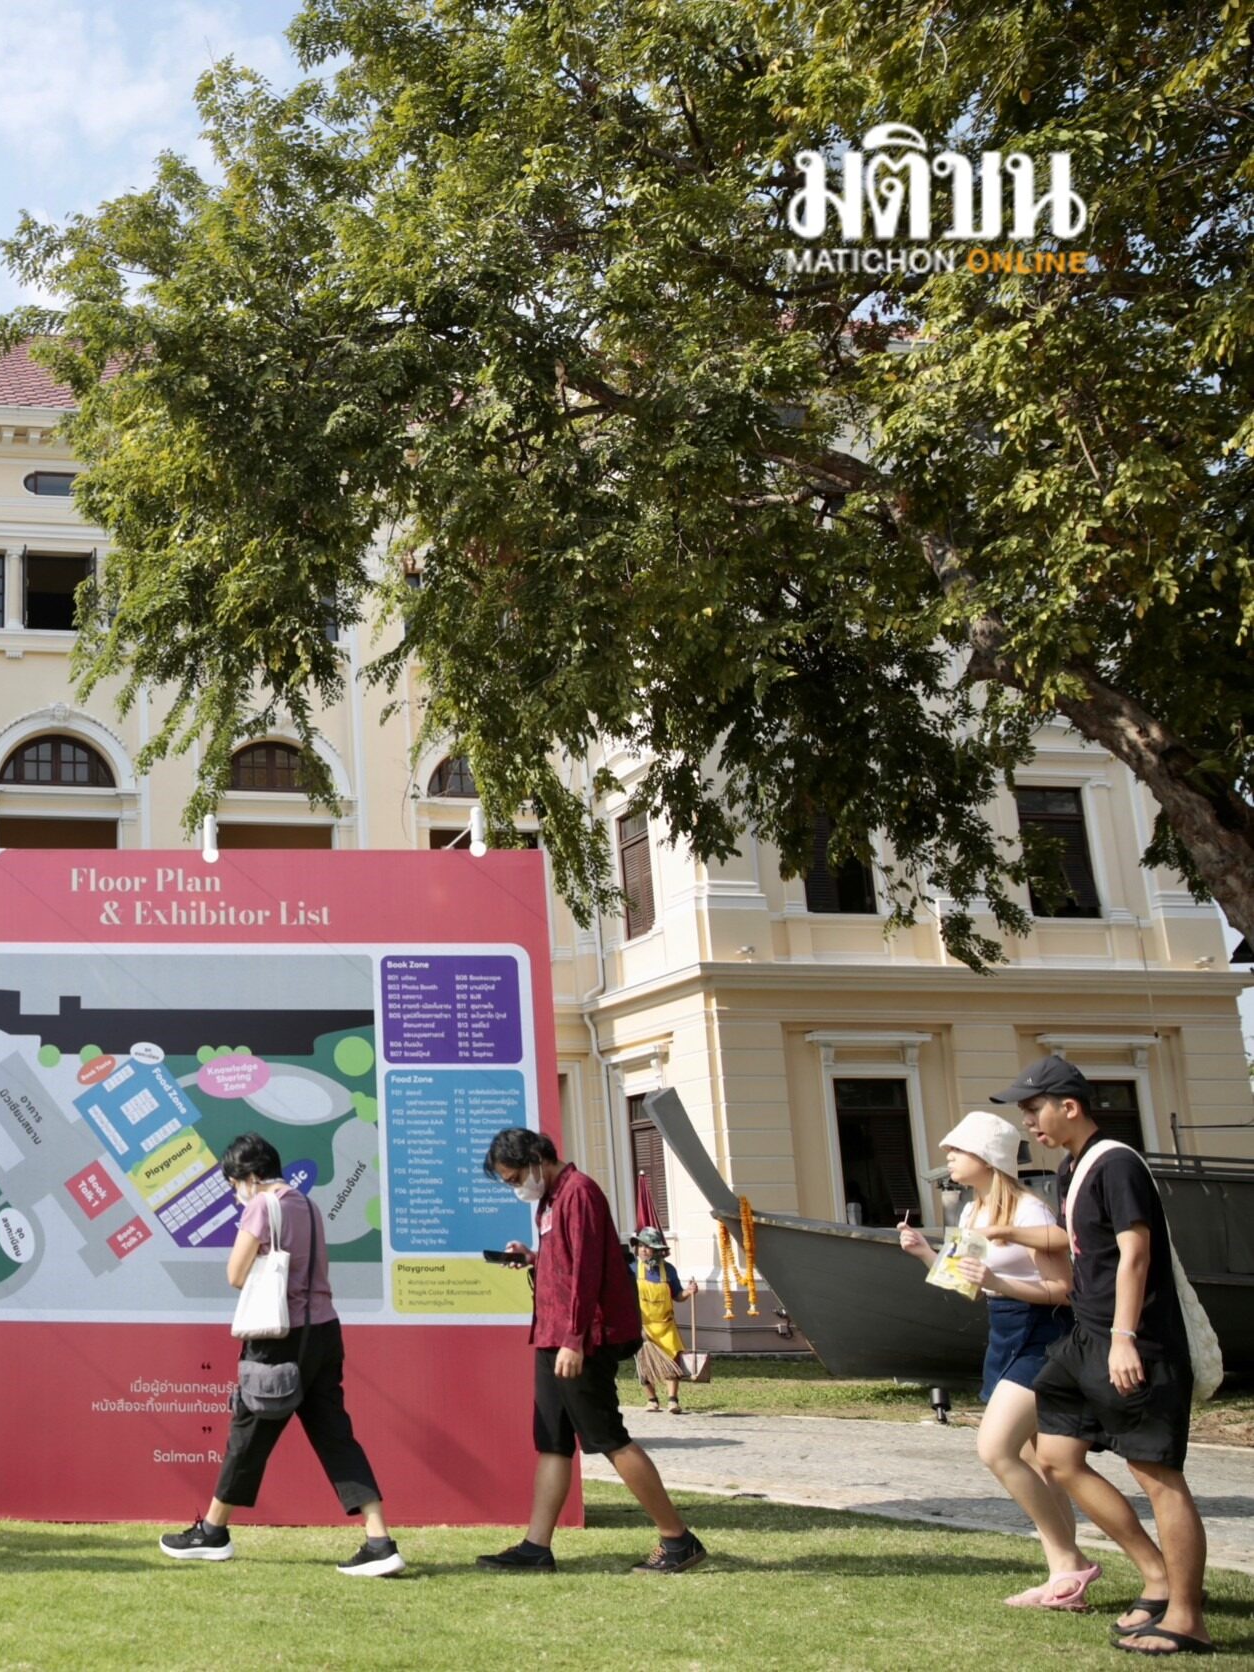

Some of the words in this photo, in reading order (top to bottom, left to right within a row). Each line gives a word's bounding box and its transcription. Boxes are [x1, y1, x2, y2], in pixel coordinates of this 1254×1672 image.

[70, 868, 147, 892] Floor
[155, 868, 221, 892] Plan
[99, 901, 122, 926] &
[134, 900, 270, 926] Exhibitor
[280, 901, 332, 926] List
[387, 960, 407, 968] Book
[206, 1063, 258, 1076] Knowledge
[216, 1073, 251, 1083] Sharing
[391, 1076, 412, 1084] Food
[152, 1068, 172, 1092] Food
[169, 1090, 187, 1115] Zone
[224, 1083, 246, 1092] Zone
[20, 1094, 43, 1124] อาคาร
[144, 1142, 193, 1180] Playground
[88, 1174, 106, 1200] Book
[290, 1170, 308, 1189] sic
[78, 1180, 94, 1202] Talk
[116, 1226, 136, 1242] Book
[121, 1236, 138, 1250] Talk
[398, 1264, 445, 1274] Playground
[153, 1450, 204, 1464] Salman
